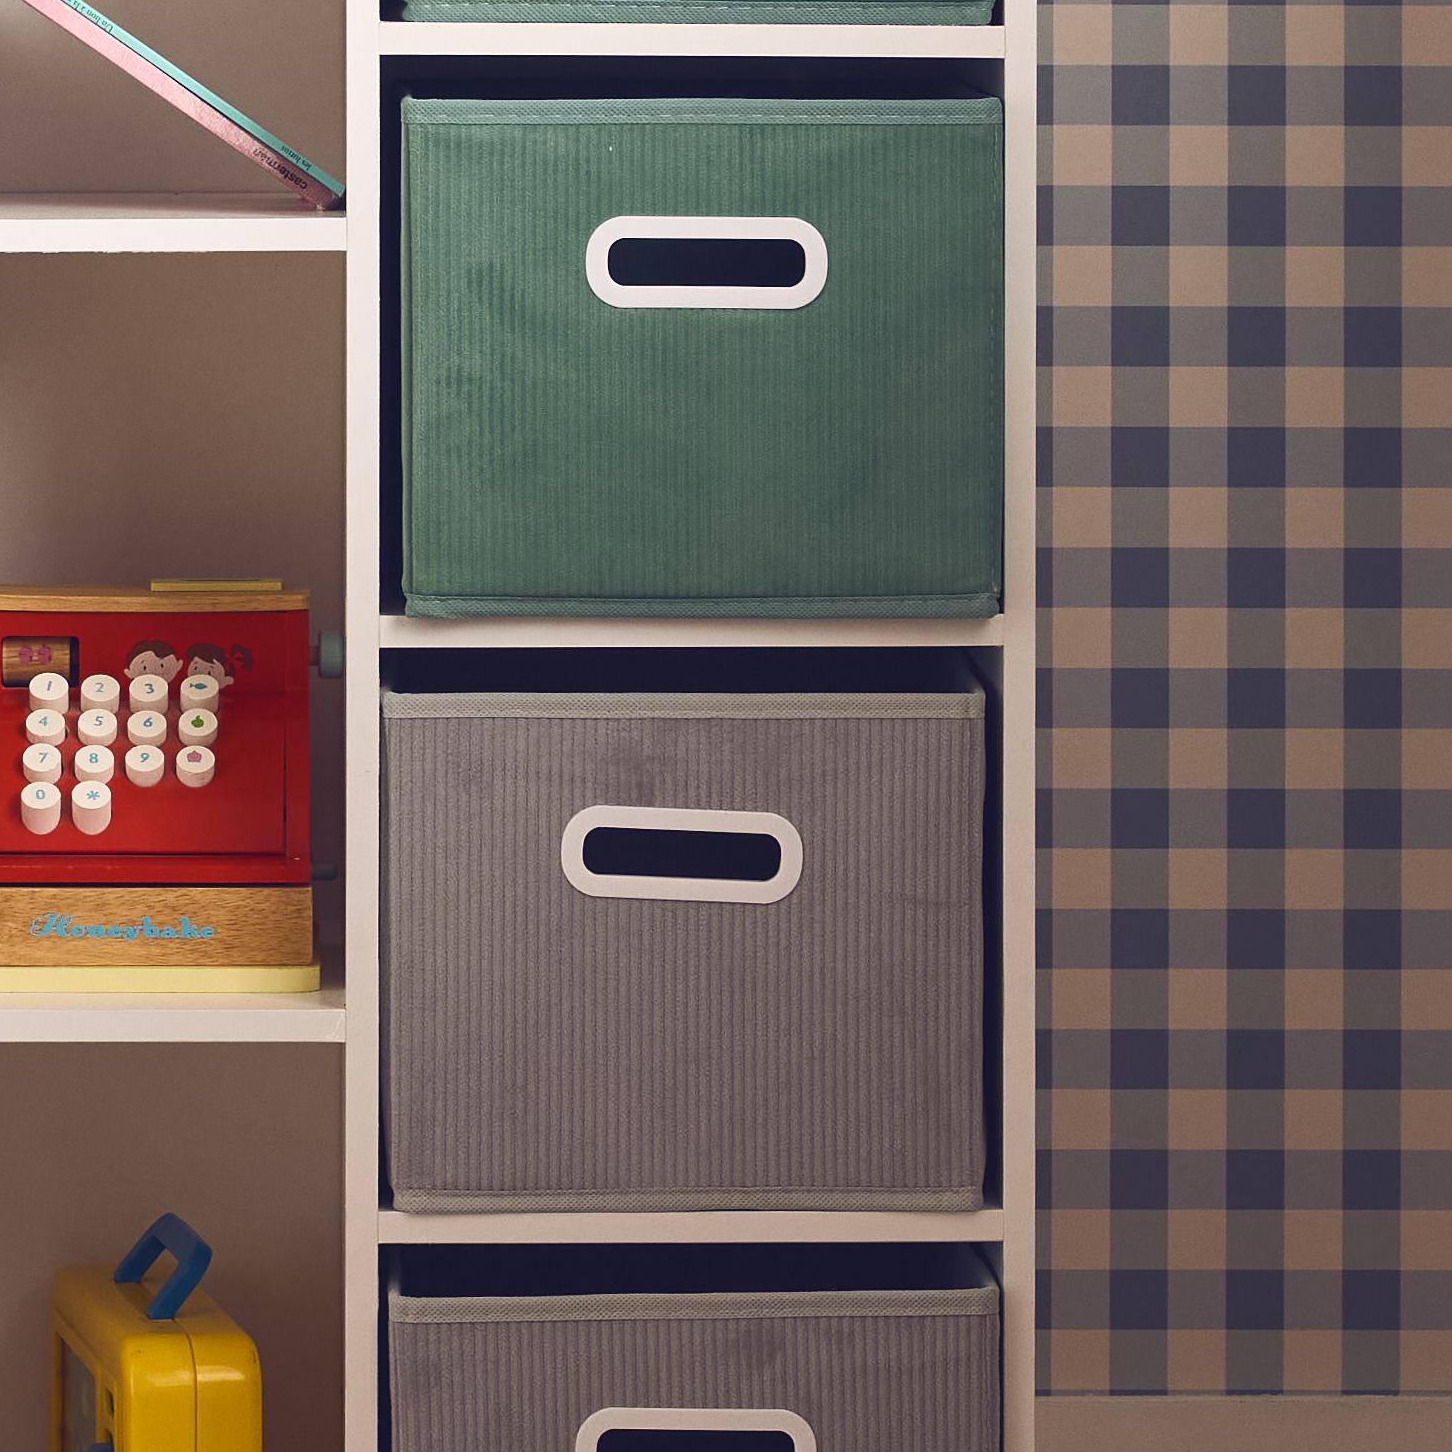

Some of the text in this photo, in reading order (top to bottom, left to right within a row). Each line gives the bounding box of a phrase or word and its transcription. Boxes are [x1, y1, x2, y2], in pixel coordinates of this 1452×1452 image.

[250, 146, 309, 191] casterman
[46, 681, 155, 694] 1 2 3
[39, 716, 153, 728] 4 5 6
[38, 752, 150, 763] 7 8 9
[29, 913, 217, 940] Honeybake
